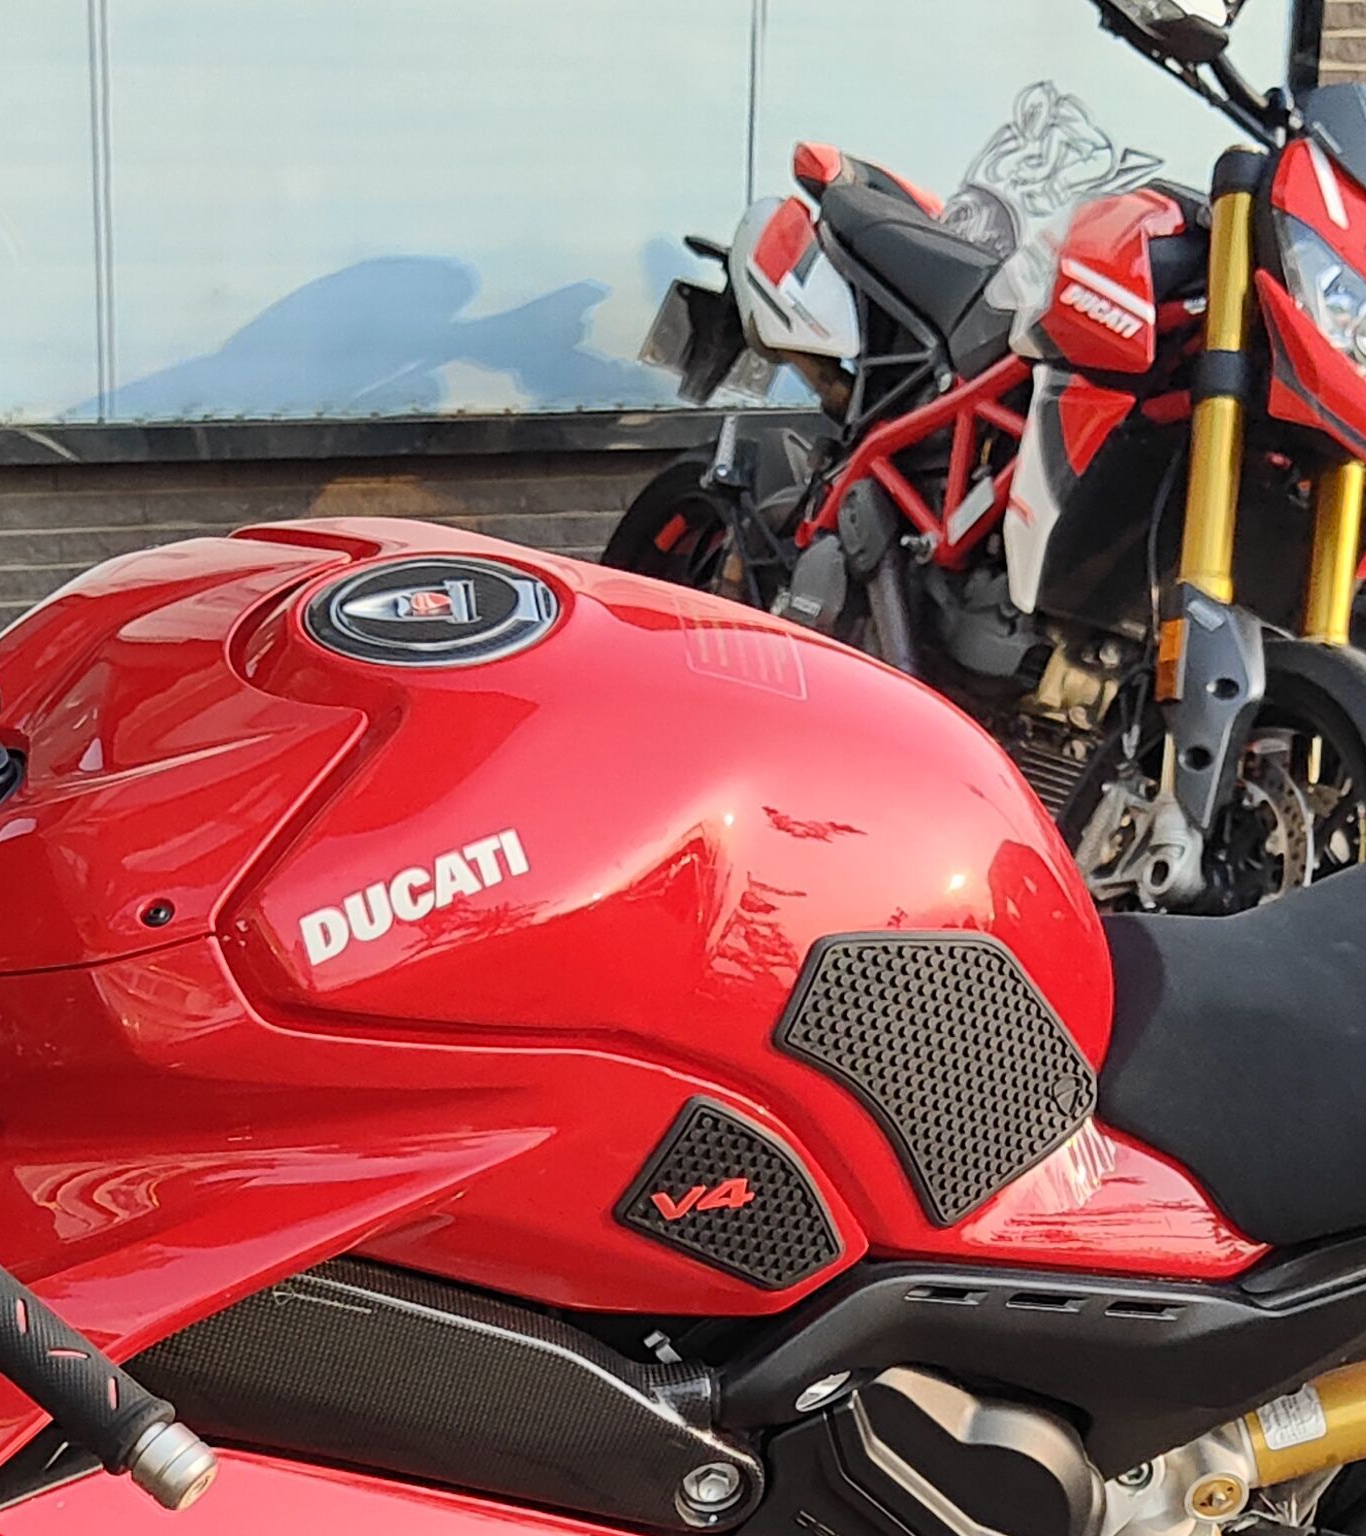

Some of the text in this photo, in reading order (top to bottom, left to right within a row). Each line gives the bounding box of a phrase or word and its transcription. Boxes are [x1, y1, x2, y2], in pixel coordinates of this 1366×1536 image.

[1060, 282, 1143, 338] DUCATI
[299, 828, 530, 967] DUCATI
[651, 1178, 755, 1221] V4
